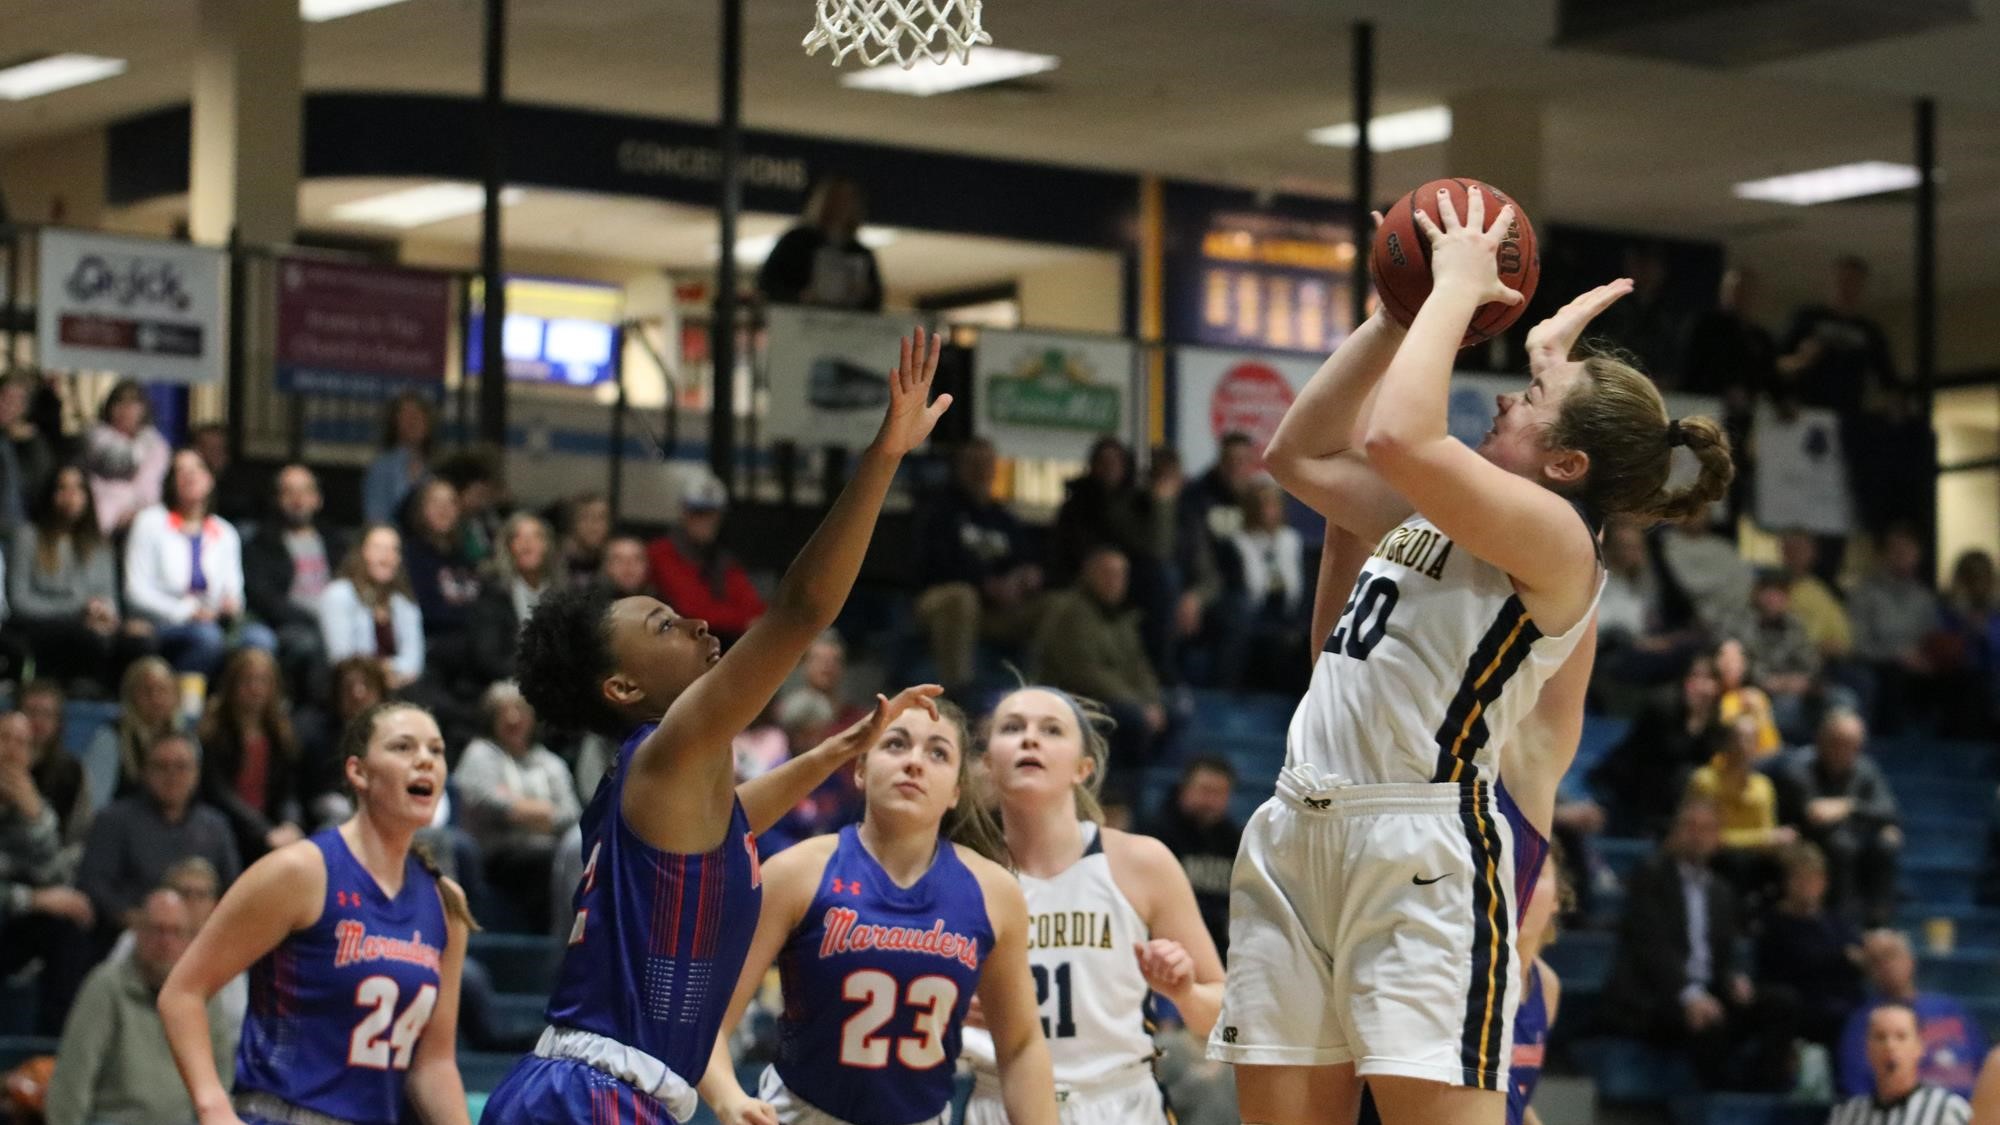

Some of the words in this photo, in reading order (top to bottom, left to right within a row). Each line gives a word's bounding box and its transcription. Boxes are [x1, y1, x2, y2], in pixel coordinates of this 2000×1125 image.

[819, 907, 978, 970] Marauders
[347, 974, 439, 1070] 24
[839, 968, 959, 1070] 23
[1030, 962, 1076, 1039] 21
